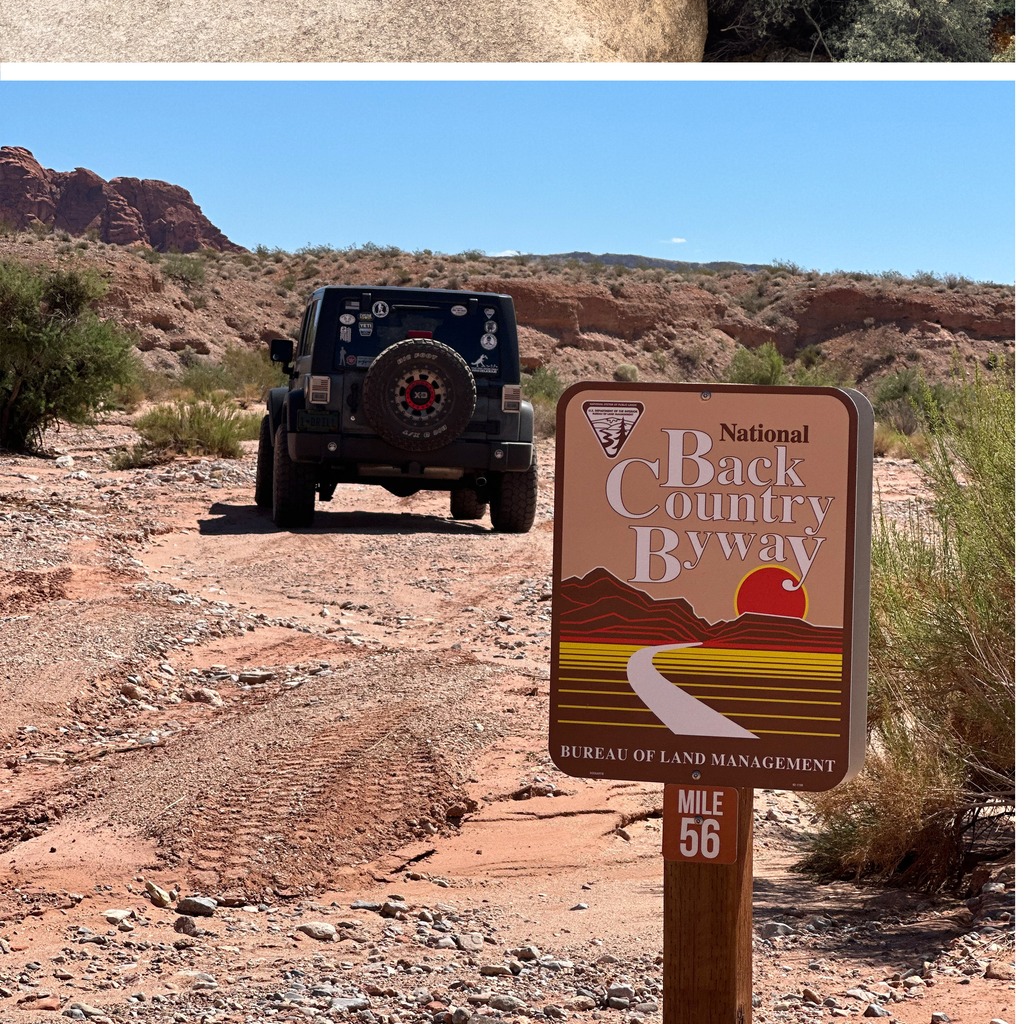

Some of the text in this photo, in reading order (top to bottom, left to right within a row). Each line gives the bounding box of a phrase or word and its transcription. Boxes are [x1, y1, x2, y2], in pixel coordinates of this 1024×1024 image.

[719, 422, 810, 444] National
[660, 428, 806, 489] Back
[605, 457, 835, 536] Country
[627, 525, 827, 592] Byway
[560, 744, 836, 773] BUREAU OF LAND MANAGEMENT
[678, 789, 724, 816] MILE
[679, 817, 720, 859] 56
